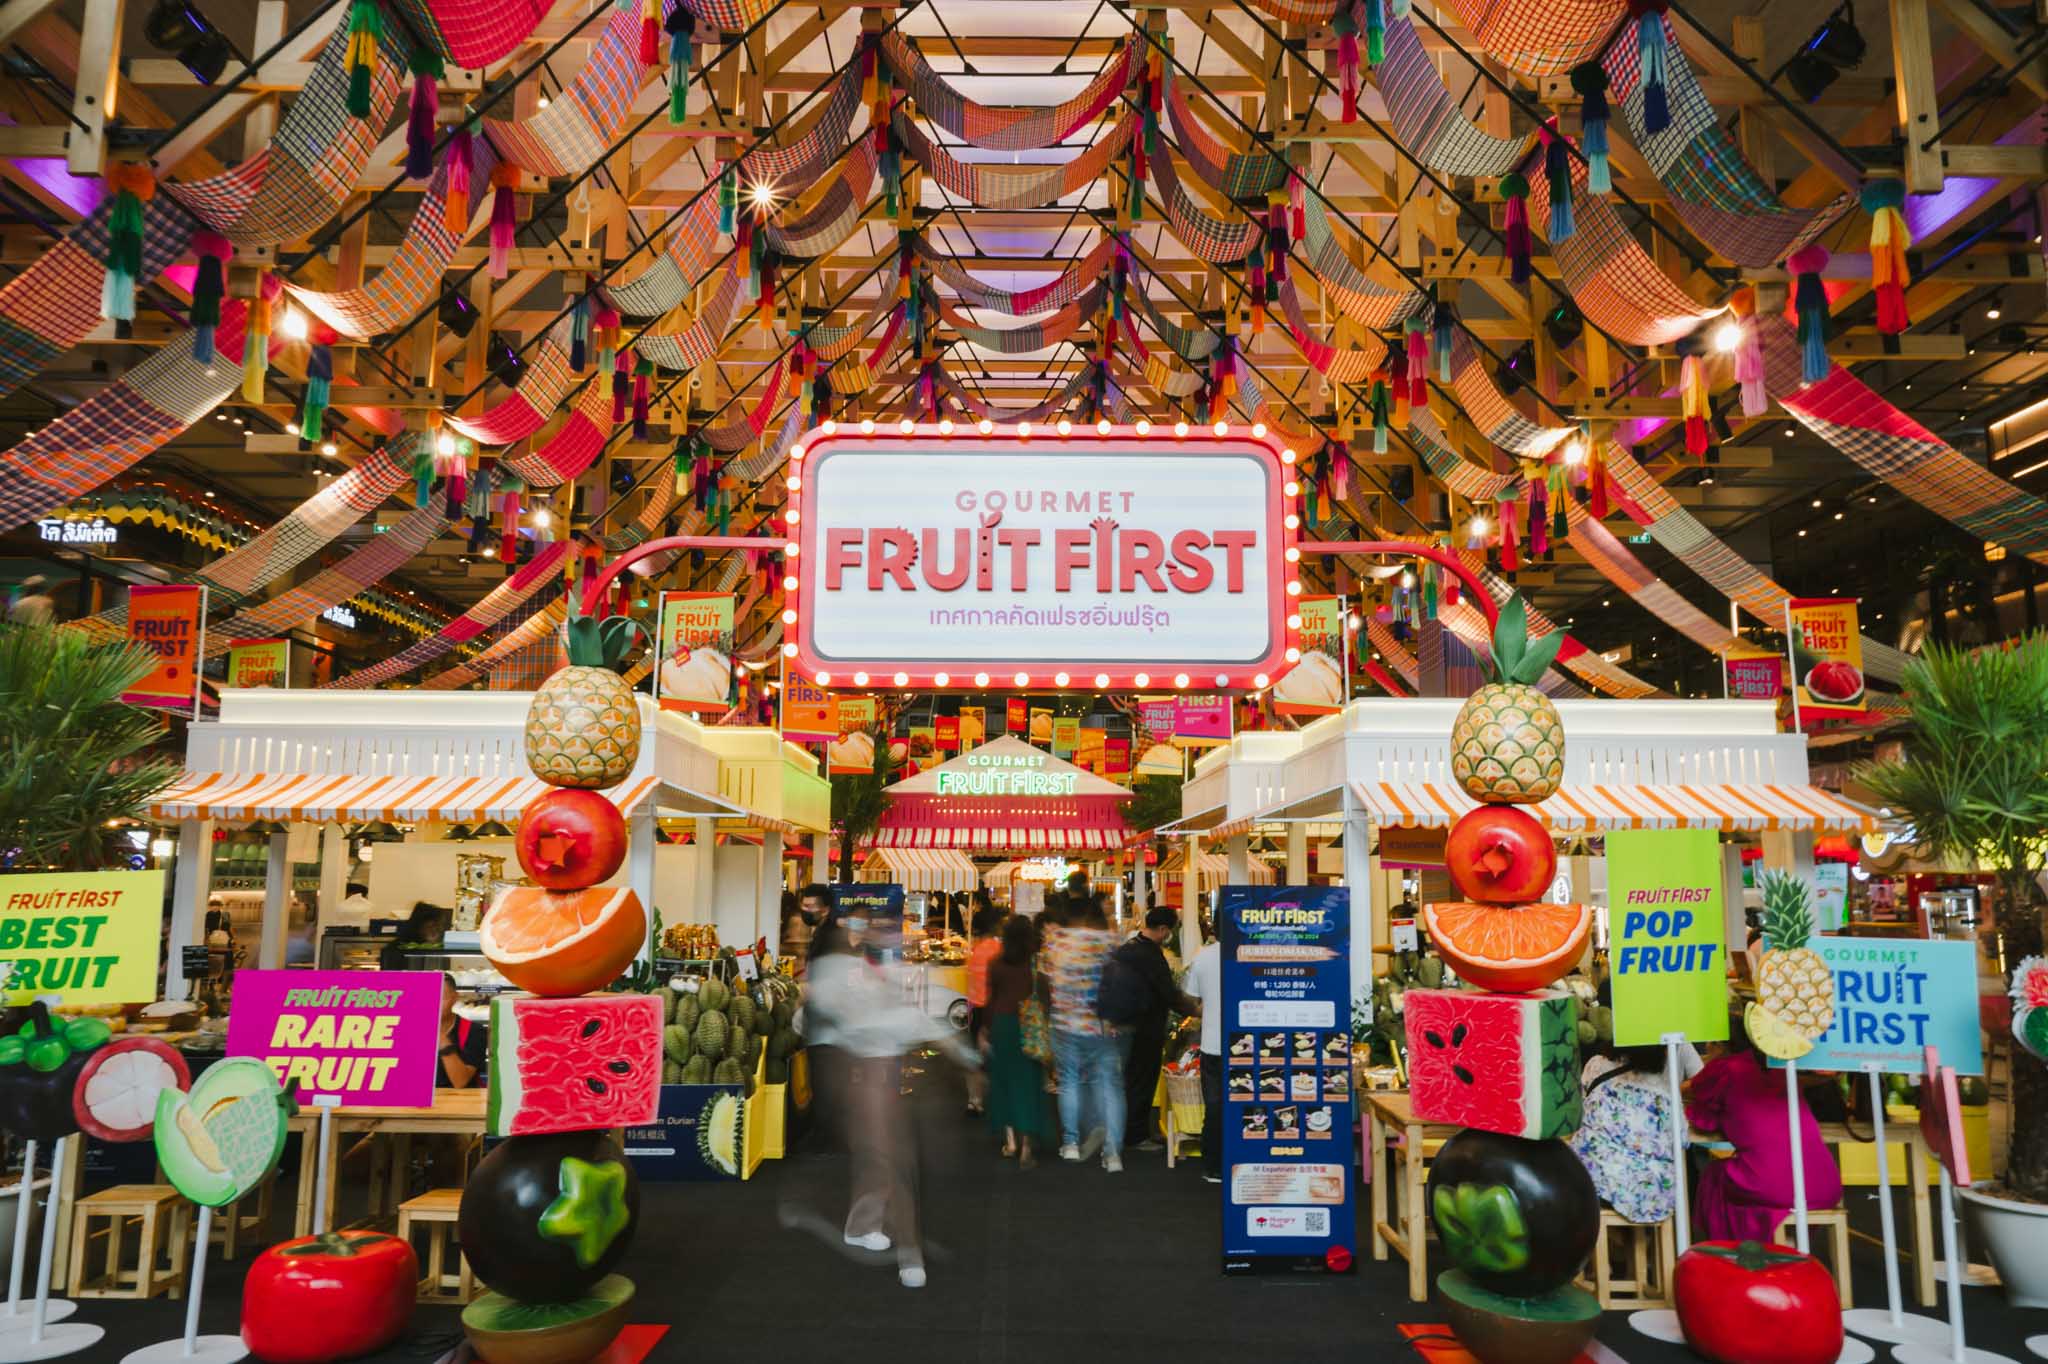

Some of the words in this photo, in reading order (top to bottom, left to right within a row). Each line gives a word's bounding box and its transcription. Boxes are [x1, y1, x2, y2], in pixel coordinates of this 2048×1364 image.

[955, 490, 1136, 513] GOURMET
[825, 514, 1042, 592] FRUIT
[1055, 517, 1257, 594] FIRST
[1301, 616, 1327, 630] UIT
[1803, 618, 1847, 634] FRUIT
[1804, 635, 1848, 650] FIRST
[968, 755, 1044, 767] GOURMET
[937, 769, 1009, 795] FRUIT
[1011, 770, 1078, 795] FIRST
[7, 889, 66, 911] FRUIT
[66, 889, 123, 908] FIRST
[1627, 887, 1671, 904] FRUIT
[1671, 887, 1711, 903] FIRST
[1241, 907, 1284, 924] FRUIT
[1285, 908, 1325, 924] FIRST
[1623, 910, 1693, 939] POP
[0, 915, 109, 950] BEST
[1618, 944, 1717, 974] FRUIT
[1824, 949, 1919, 963] GOURMET
[1830, 963, 1928, 1004] RUIT
[284, 985, 346, 1008] FRUIT
[344, 987, 403, 1008] FIRST
[269, 1014, 400, 1049] RARE
